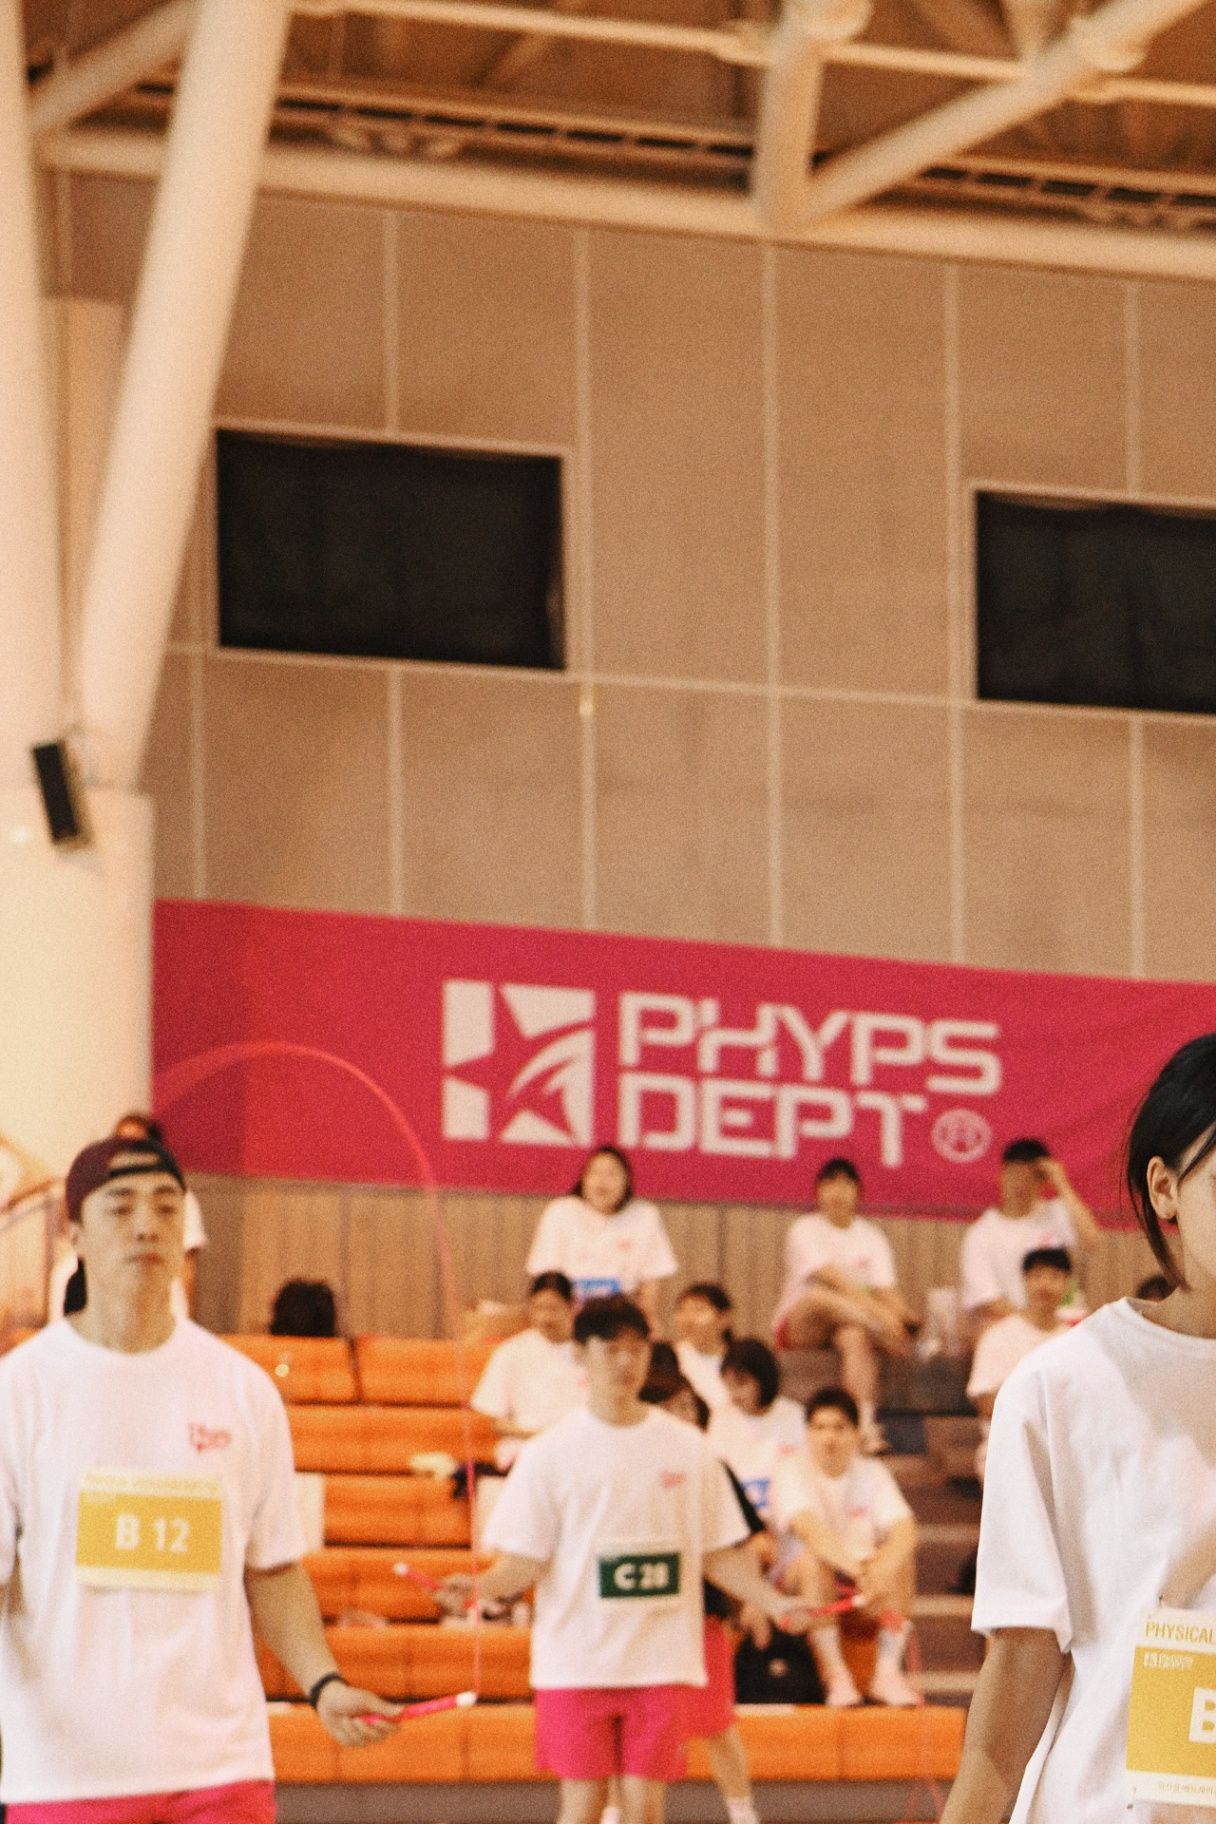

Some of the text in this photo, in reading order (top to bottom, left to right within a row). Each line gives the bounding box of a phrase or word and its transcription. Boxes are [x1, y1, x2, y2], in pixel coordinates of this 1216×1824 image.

[617, 990, 1002, 1096] PHYPS
[616, 1071, 928, 1169] DEPT
[115, 1513, 191, 1553] B 12
[613, 1562, 636, 1590] C
[1145, 1622, 1215, 1645] PHYSICAL
